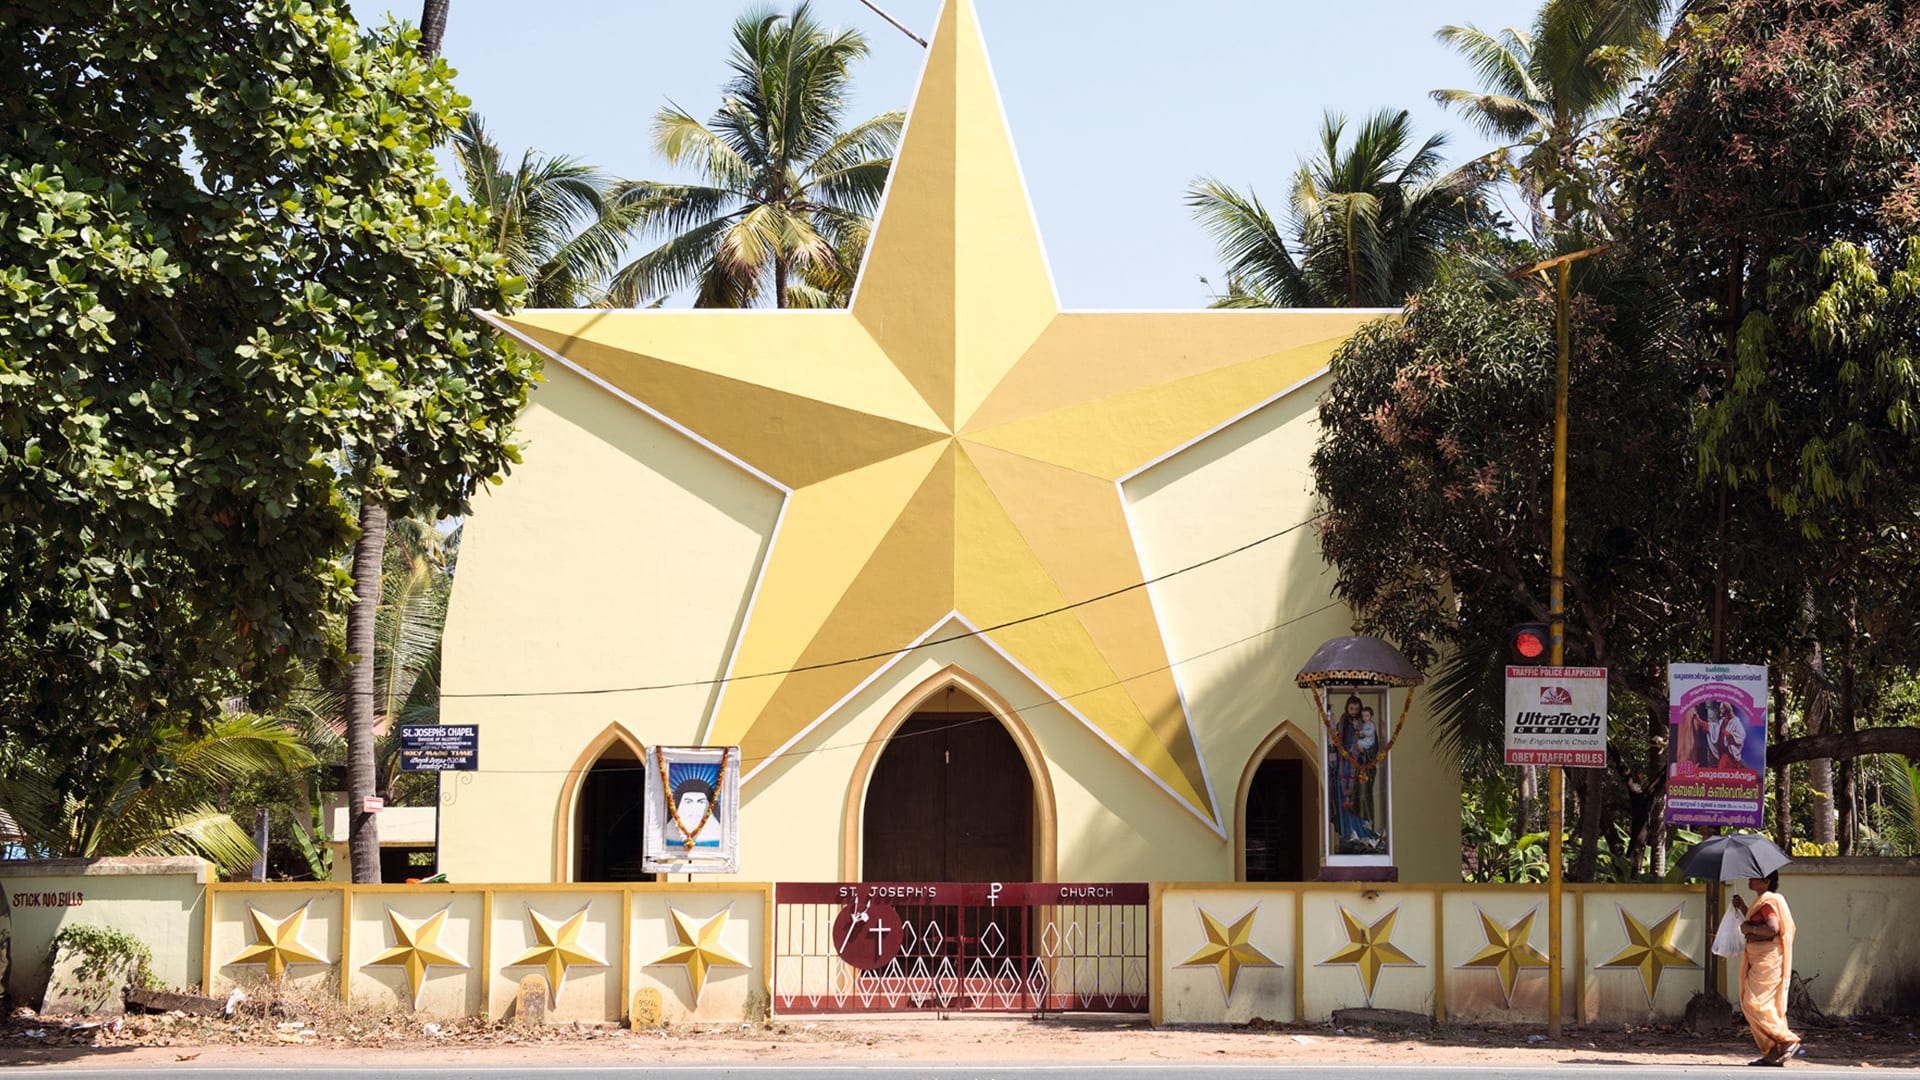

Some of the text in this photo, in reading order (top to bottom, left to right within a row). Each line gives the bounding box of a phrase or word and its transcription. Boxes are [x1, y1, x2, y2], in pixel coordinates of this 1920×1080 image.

[1512, 668, 1538, 676] TRAFFIC
[1564, 669, 1601, 677] ALAPPUZHA
[1516, 711, 1601, 727] UltraTech
[447, 727, 475, 737] CHAPEL
[1529, 738, 1569, 746] Engineer's
[1571, 738, 1599, 746] Choice
[1512, 752, 1603, 763] OBEY TRAFFIC RULES
[868, 886, 937, 897] JOSEPH'S
[1060, 887, 1114, 897] CHURCH
[13, 891, 83, 907] STICK NO BILLS
